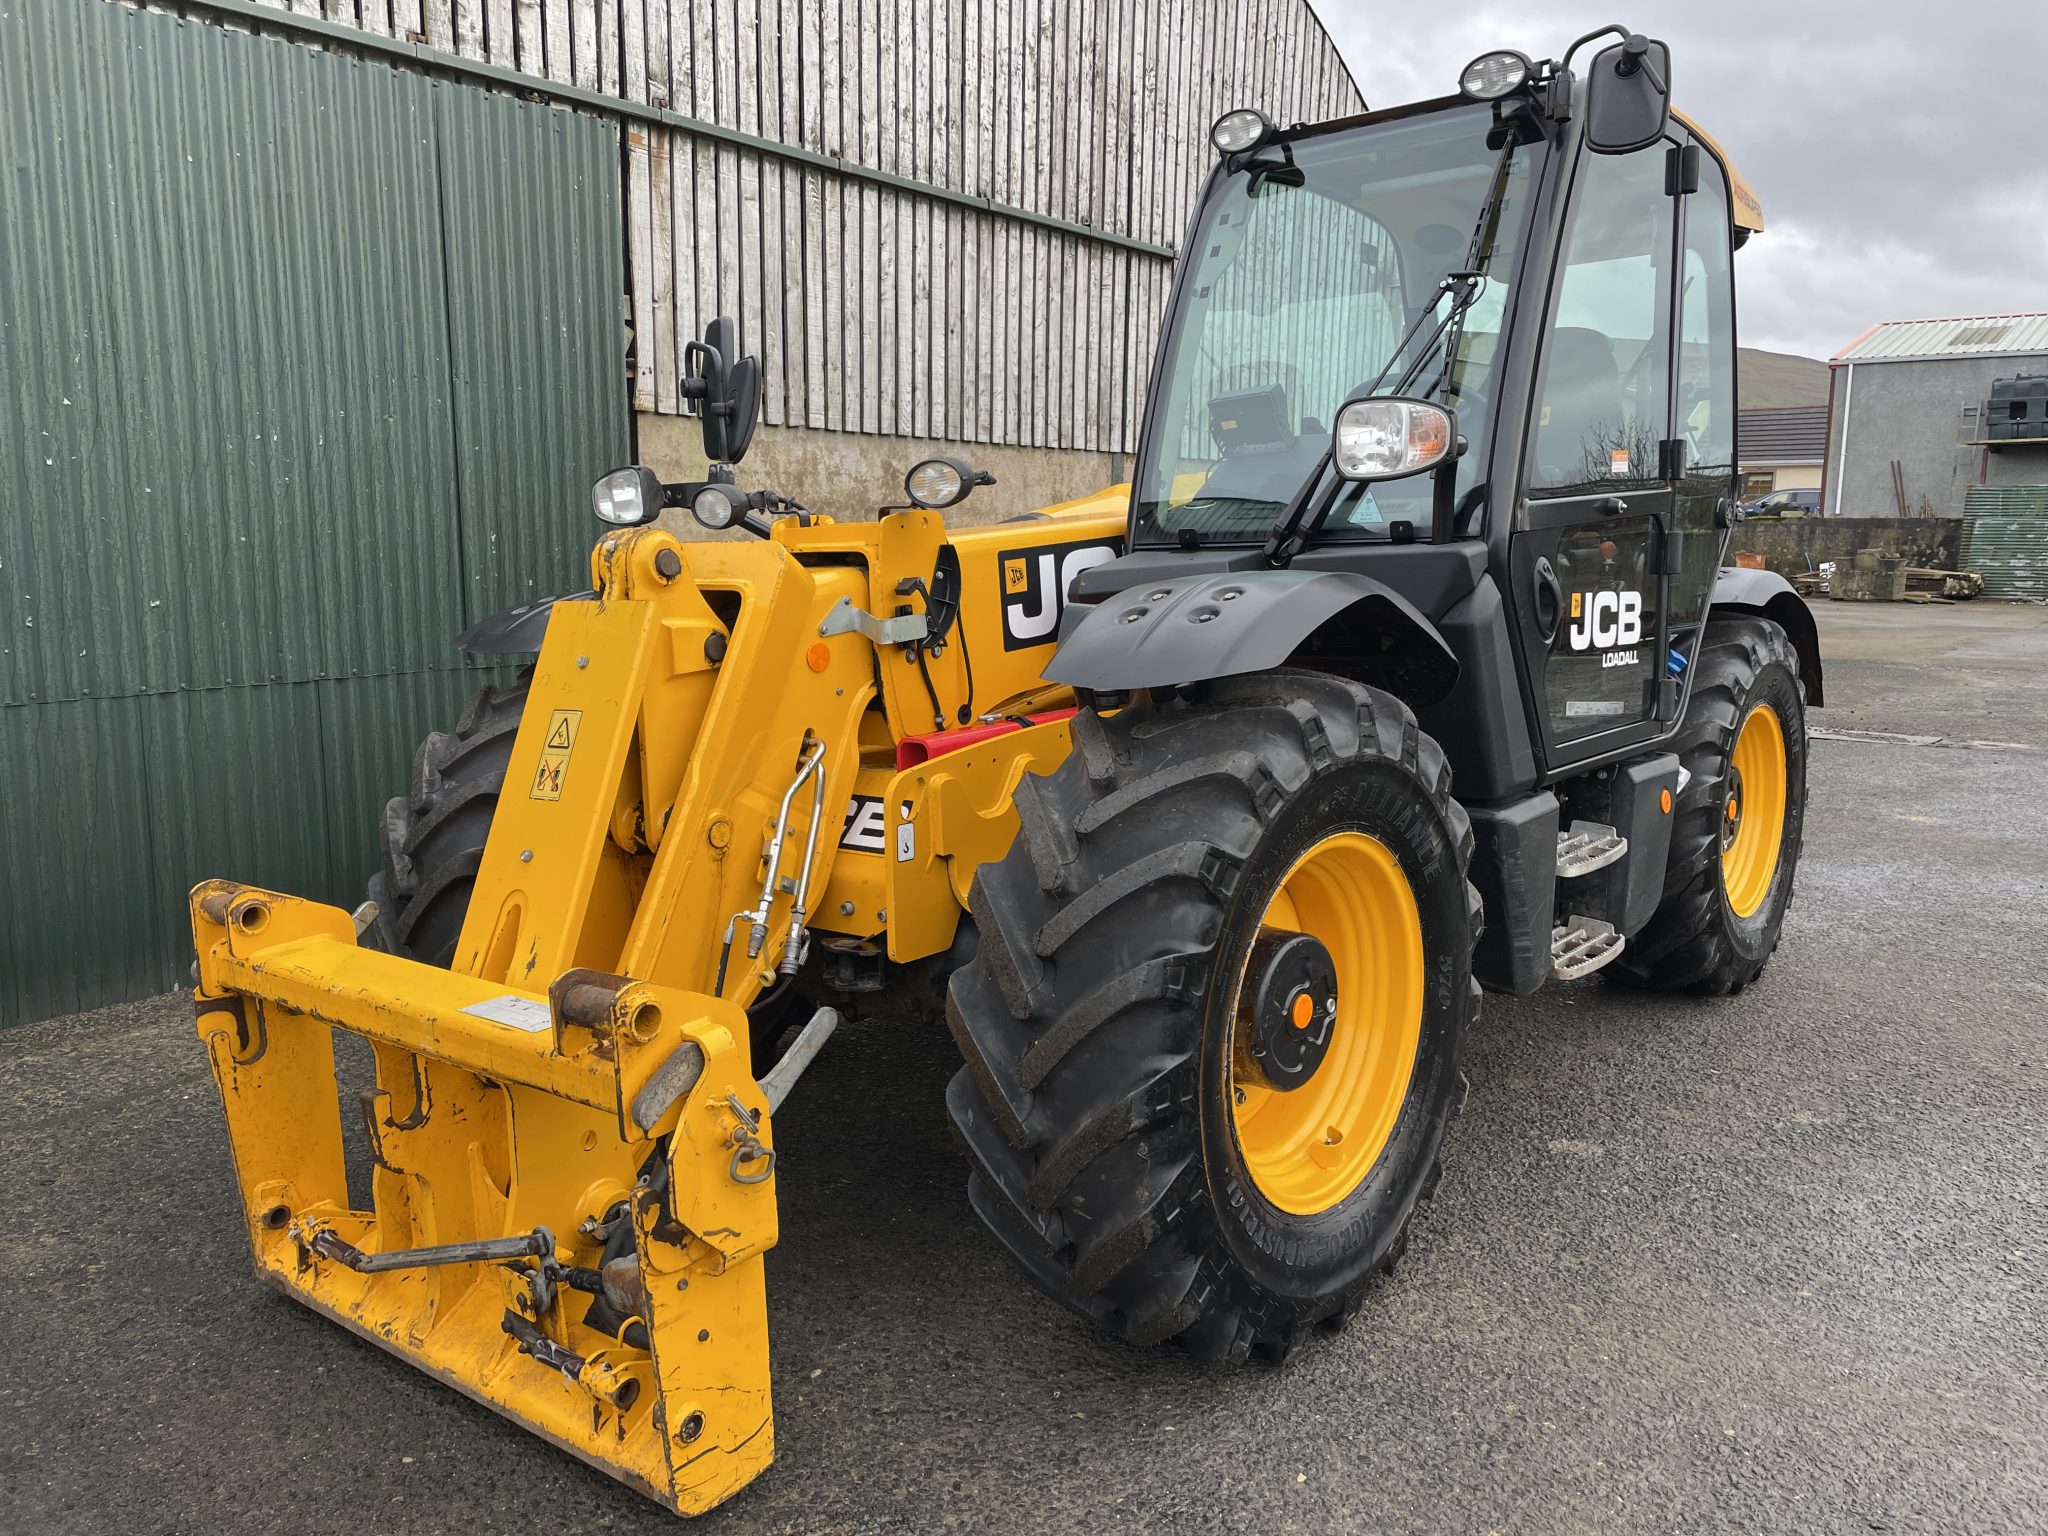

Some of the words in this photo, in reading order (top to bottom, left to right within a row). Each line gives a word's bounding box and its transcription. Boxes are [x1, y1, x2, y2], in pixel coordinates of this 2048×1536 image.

[1007, 546, 1118, 640] JC
[1010, 567, 1025, 585] JCB
[1570, 590, 1642, 651] JCB
[1602, 650, 1639, 668] LOADALL
